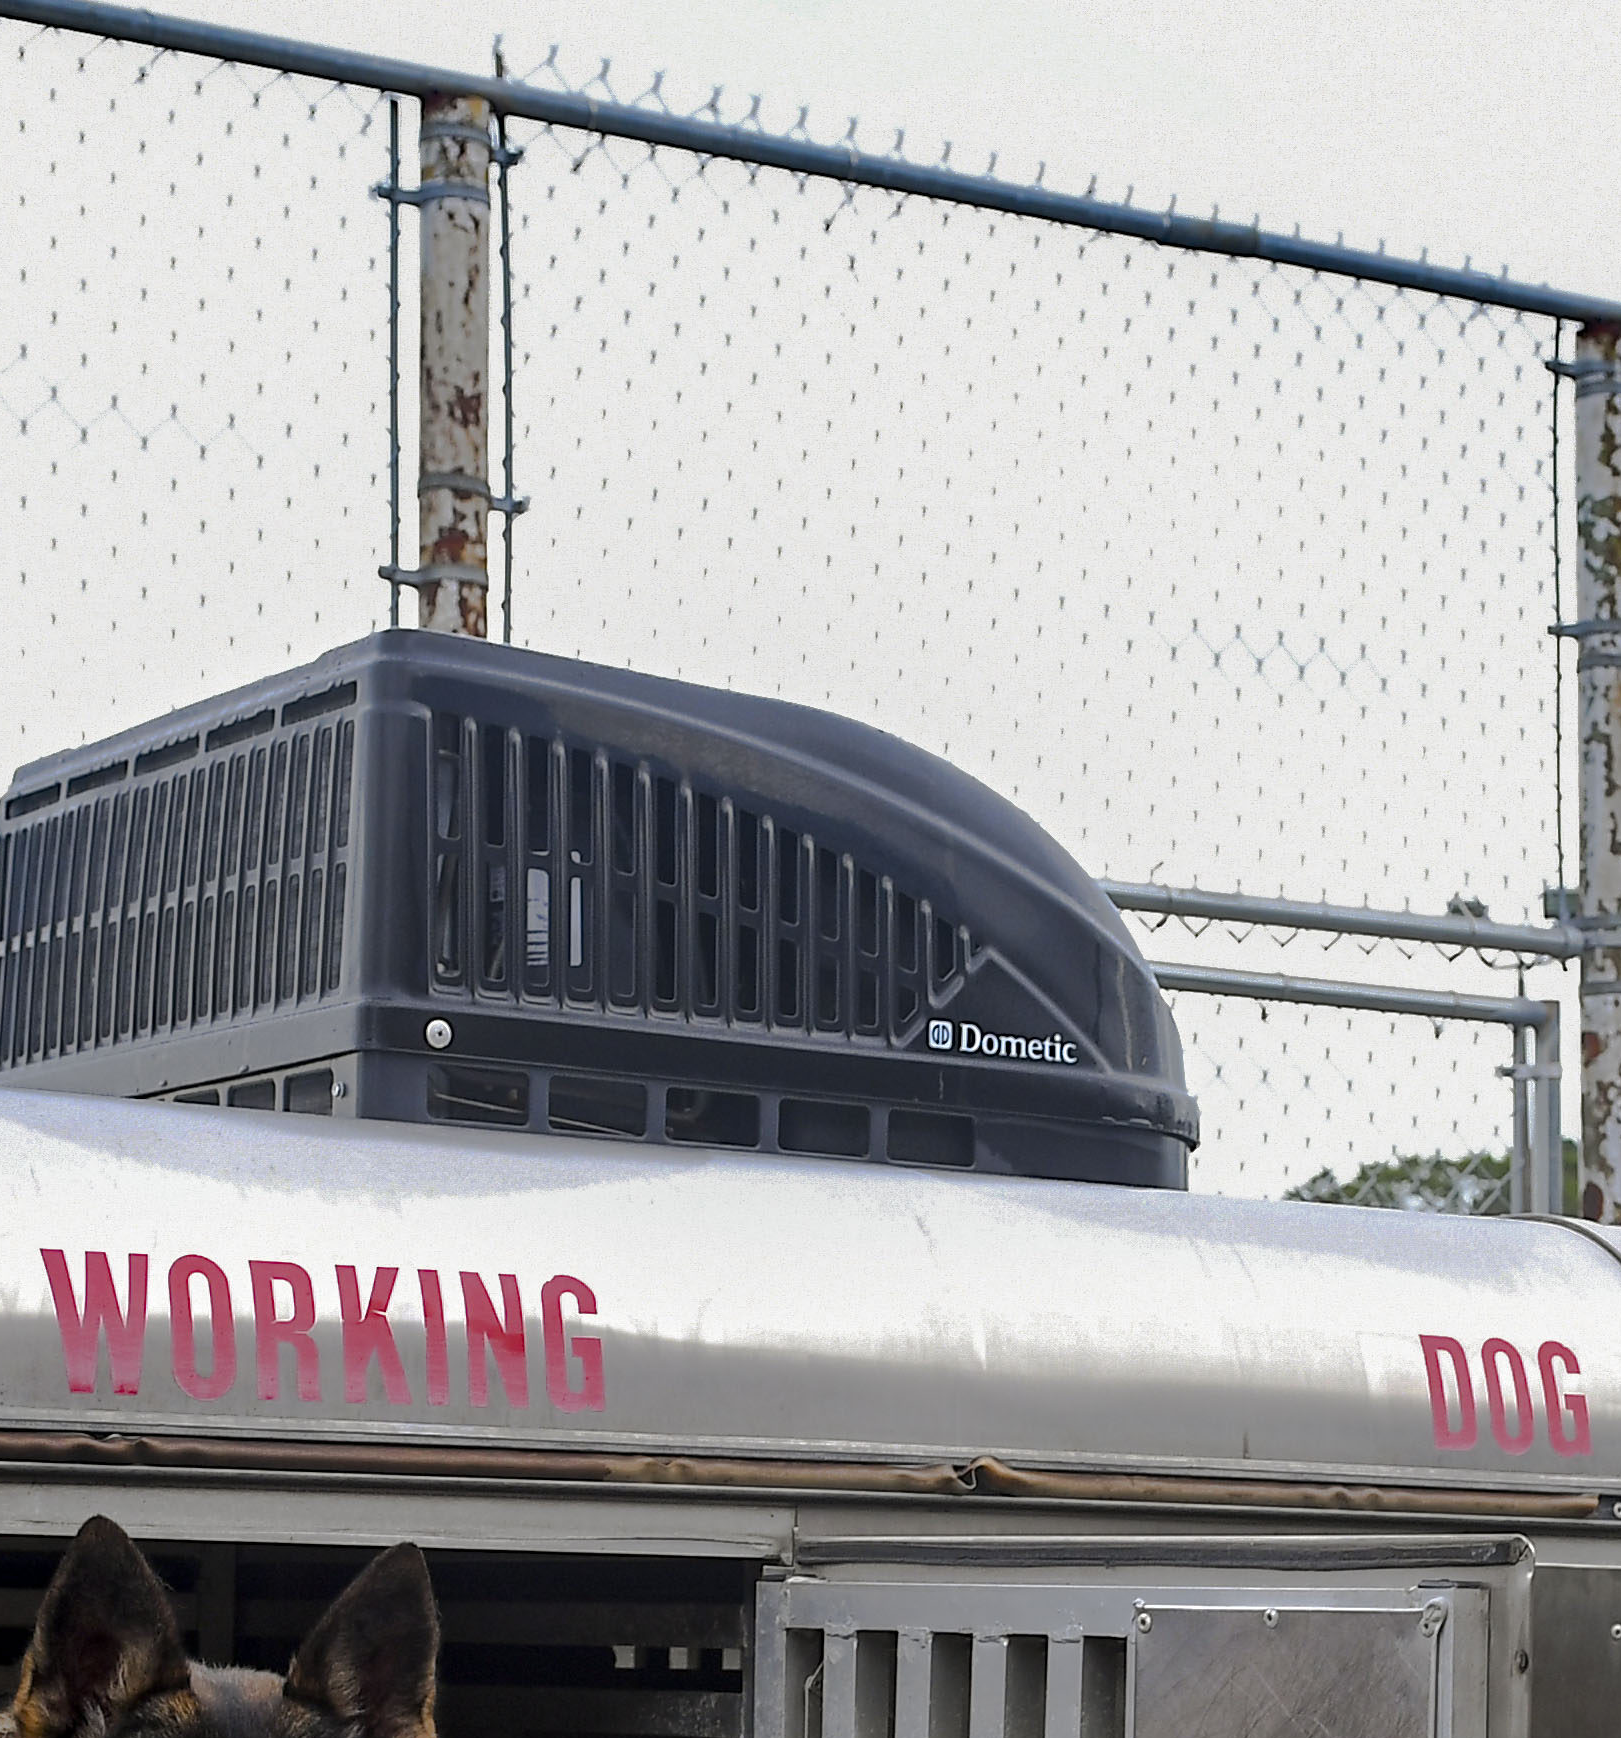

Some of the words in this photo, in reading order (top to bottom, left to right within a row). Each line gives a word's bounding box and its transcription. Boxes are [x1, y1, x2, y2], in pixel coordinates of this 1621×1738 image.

[959, 1022, 1078, 1064] Dometic
[39, 1248, 606, 1413] WORKING
[1418, 1334, 1593, 1457] DOG
